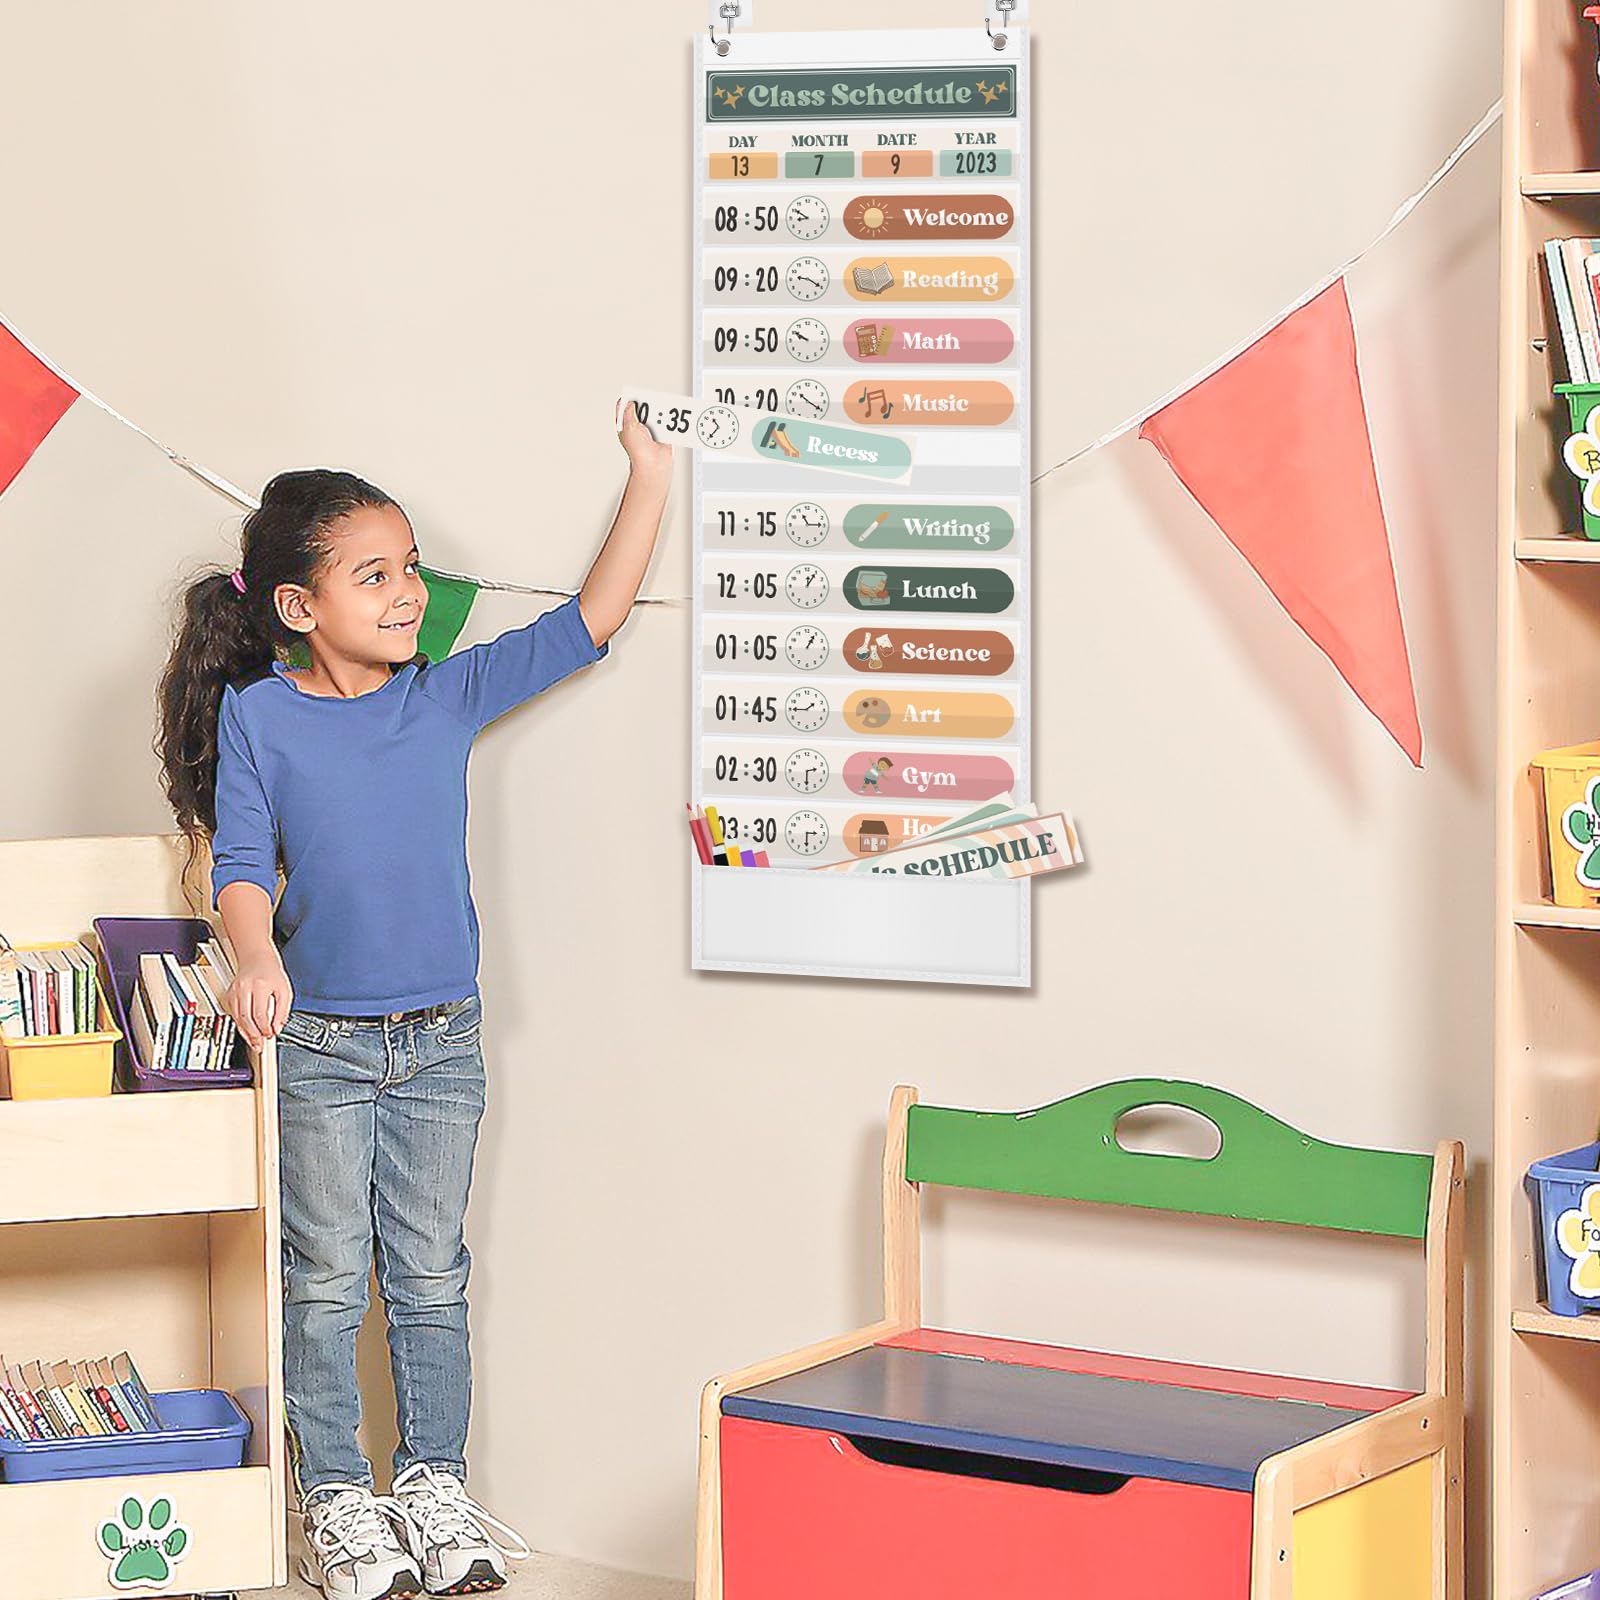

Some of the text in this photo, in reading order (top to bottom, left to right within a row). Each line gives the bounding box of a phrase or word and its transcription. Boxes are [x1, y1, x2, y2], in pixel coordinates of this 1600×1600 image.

[748, 81, 972, 108] Class Schedule
[728, 131, 997, 149] DAY MONTH DATE YEAR
[731, 151, 997, 177] 13 7 9 2023
[903, 208, 1009, 227] Welcome
[902, 270, 999, 296] Reading
[902, 331, 960, 351] Math
[902, 392, 969, 412] Music
[806, 435, 879, 464] Recess
[903, 518, 991, 545] Writing
[902, 580, 978, 600] Lunch
[902, 642, 992, 663] Science
[902, 704, 942, 724] Art
[902, 766, 957, 792] Gym
[904, 832, 1057, 877] SCHEDULE
